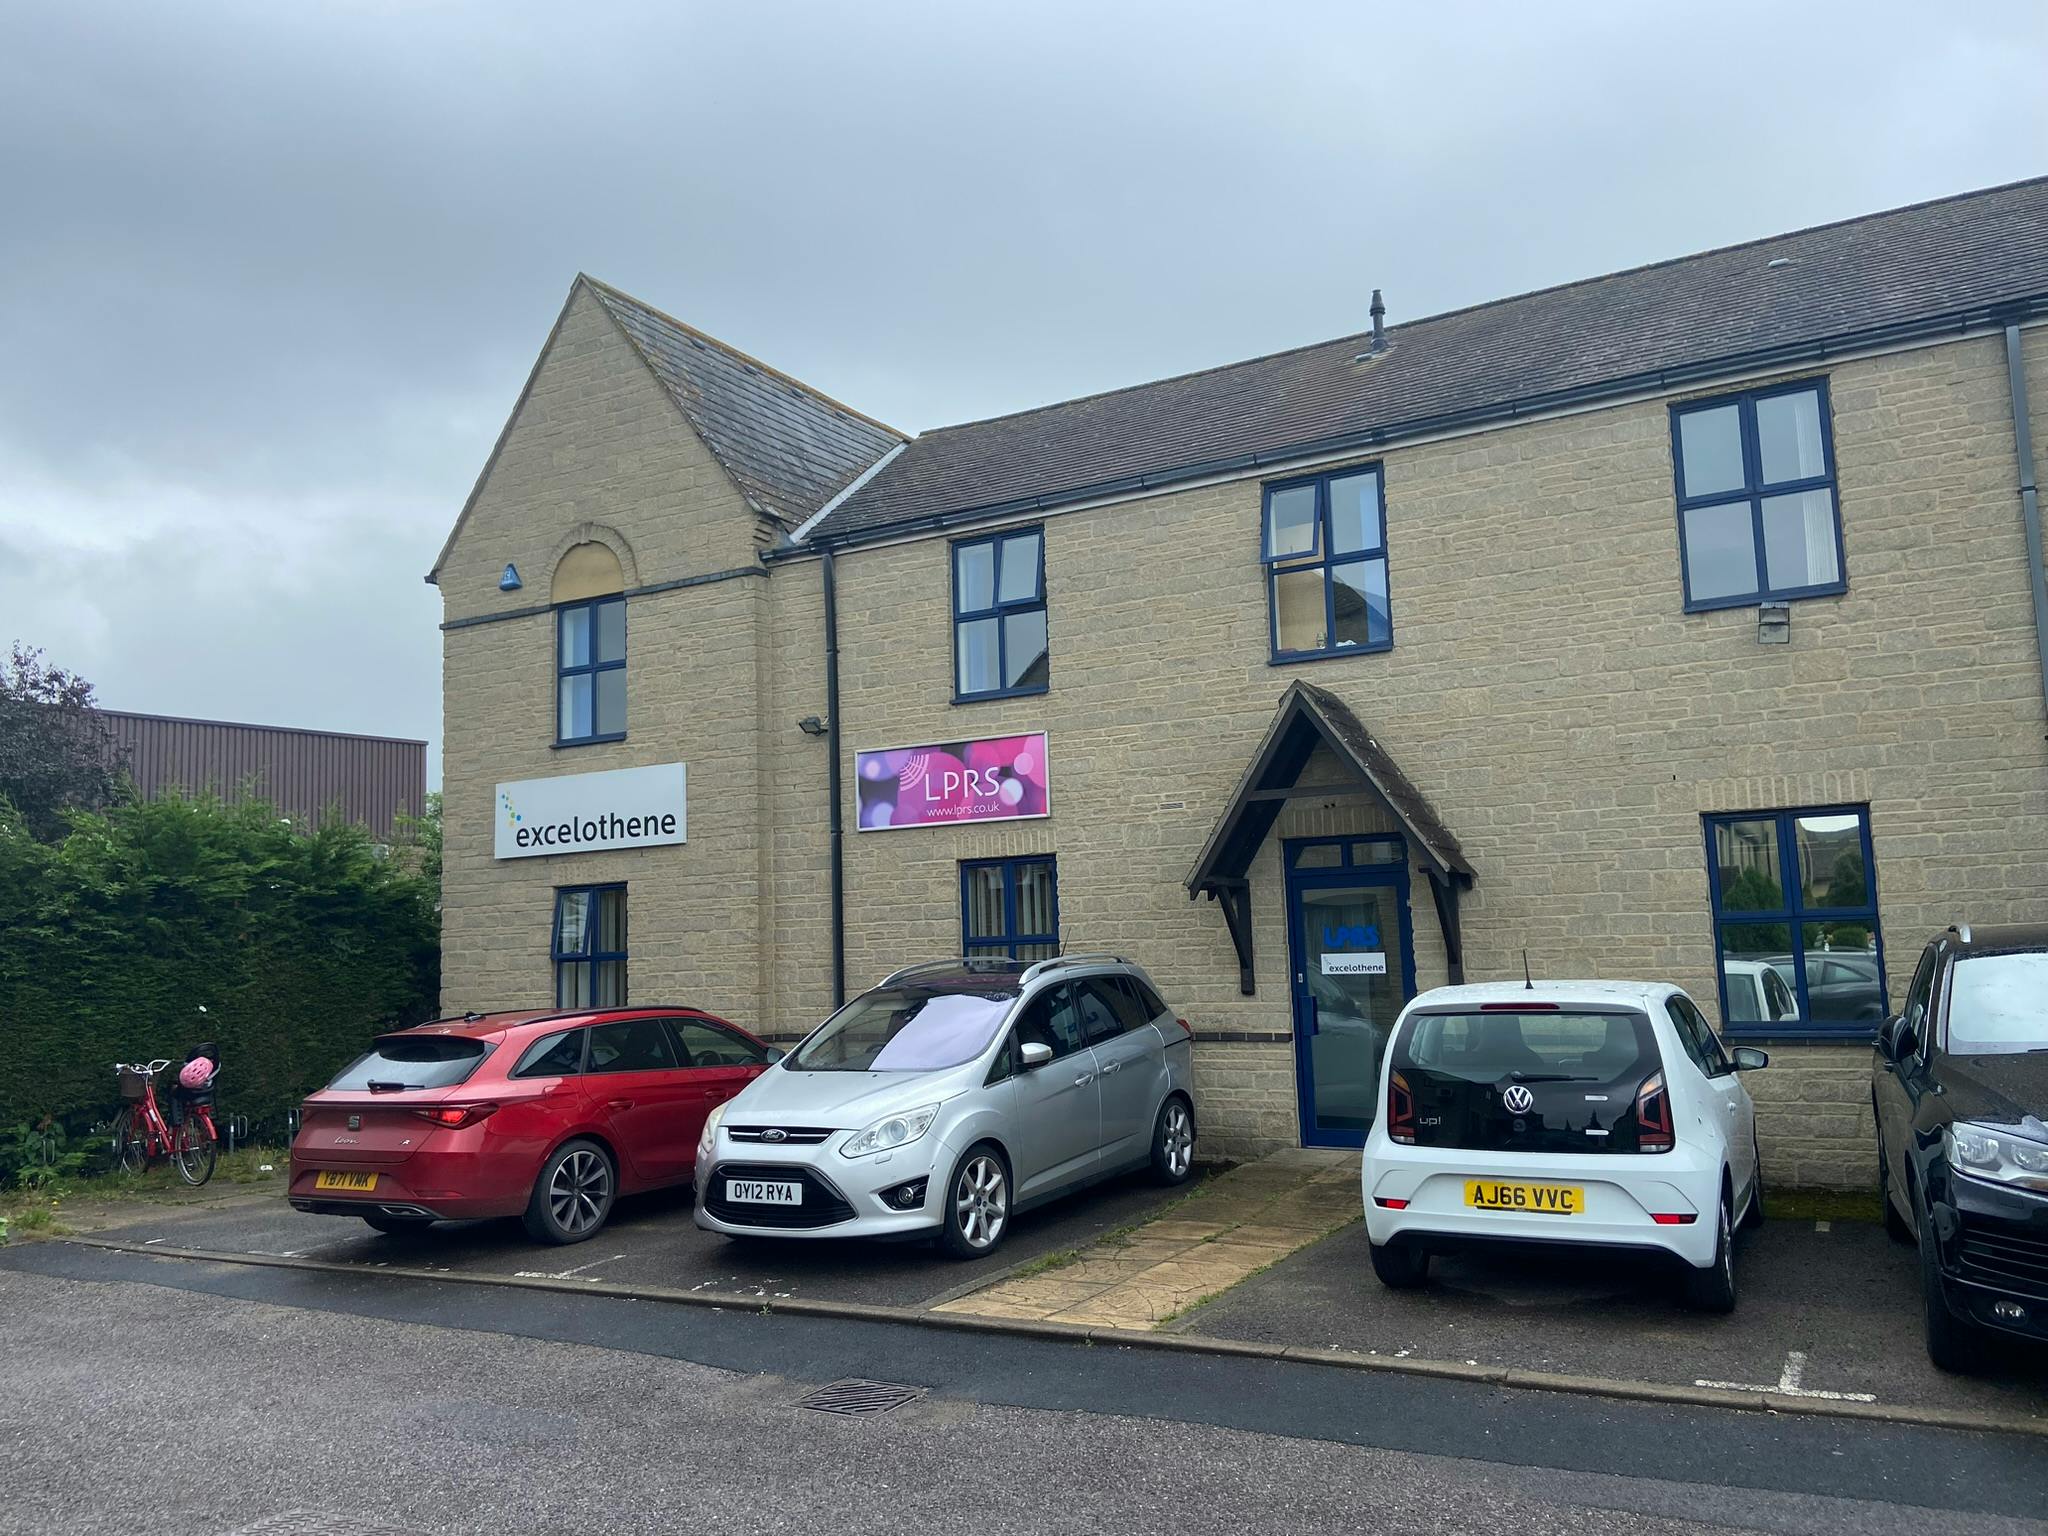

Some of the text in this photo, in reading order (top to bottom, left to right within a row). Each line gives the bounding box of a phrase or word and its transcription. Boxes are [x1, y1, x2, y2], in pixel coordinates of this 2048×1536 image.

[925, 766, 1000, 801] LPRS
[927, 801, 1000, 817] www.lprs.co.uk
[516, 812, 677, 848] excelothene
[1329, 963, 1384, 973] excelothene
[734, 1183, 793, 1201] OY12 RYA
[1473, 1185, 1574, 1209] AJ66 VVC
